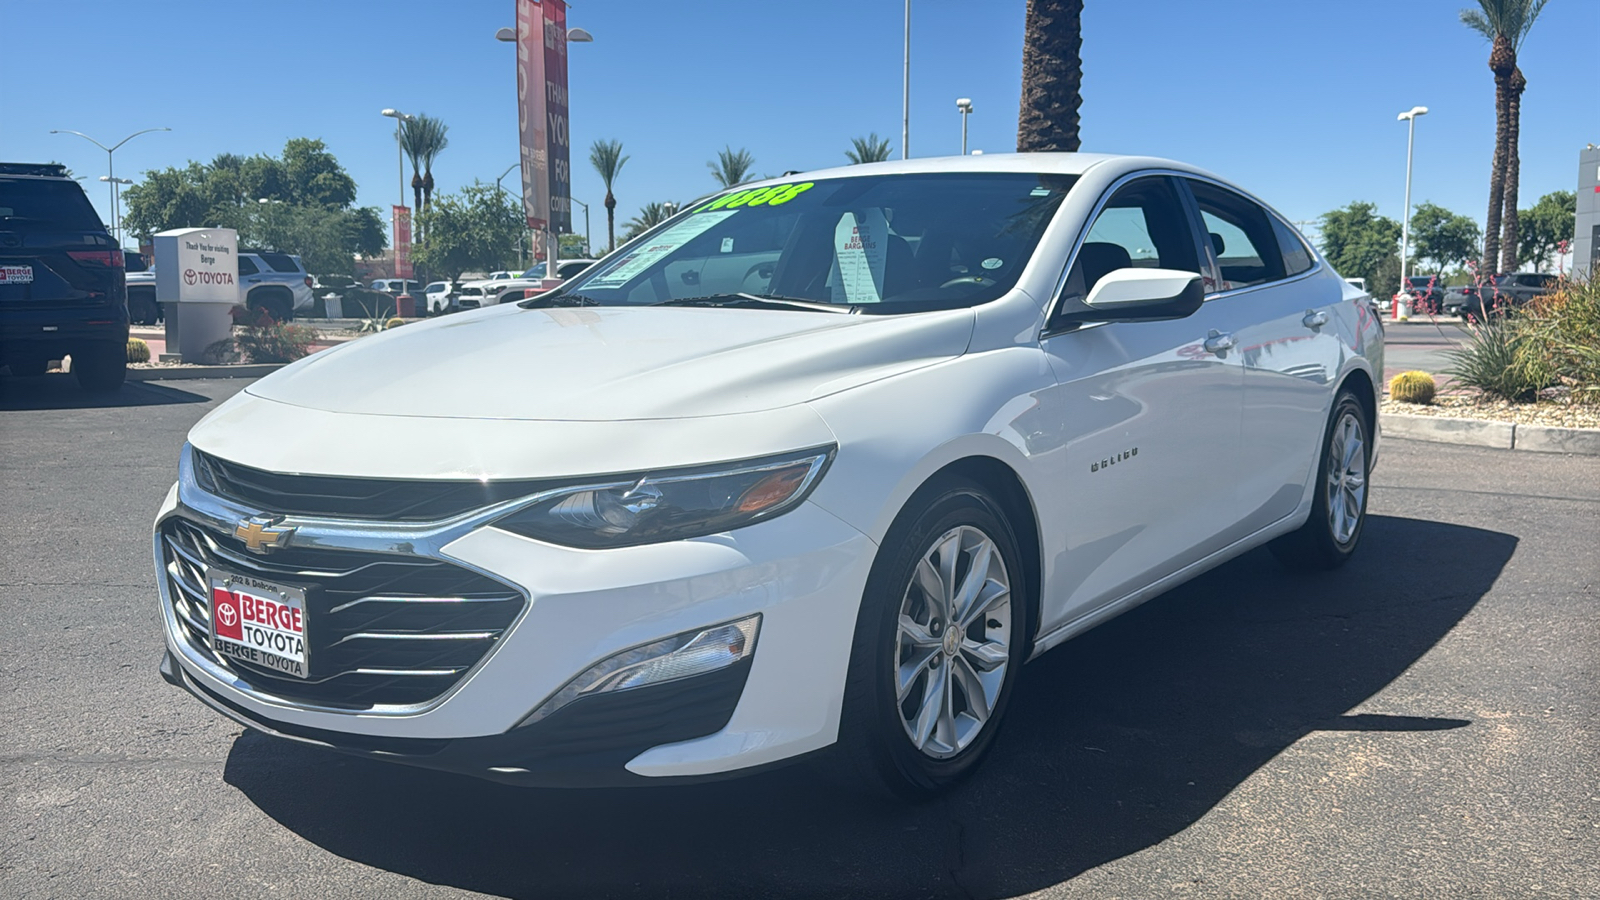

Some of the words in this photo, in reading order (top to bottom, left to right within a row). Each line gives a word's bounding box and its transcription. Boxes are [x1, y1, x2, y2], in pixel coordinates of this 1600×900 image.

[546, 81, 568, 108] THAN
[555, 158, 568, 184] FOR
[185, 241, 199, 250] Thank
[199, 243, 207, 251] You
[214, 244, 230, 254] visiting
[844, 242, 877, 251] BARGAINS
[851, 235, 871, 243] BERGE
[200, 254, 215, 266] Berge
[198, 271, 234, 285] TOYOTA
[231, 574, 244, 585] 202
[245, 577, 250, 586] &
[252, 580, 278, 593] Dobson
[242, 595, 303, 633] BERGE
[244, 626, 304, 655] TOYOTA
[215, 640, 258, 662] BERGE
[261, 651, 303, 676] TOYOTA
